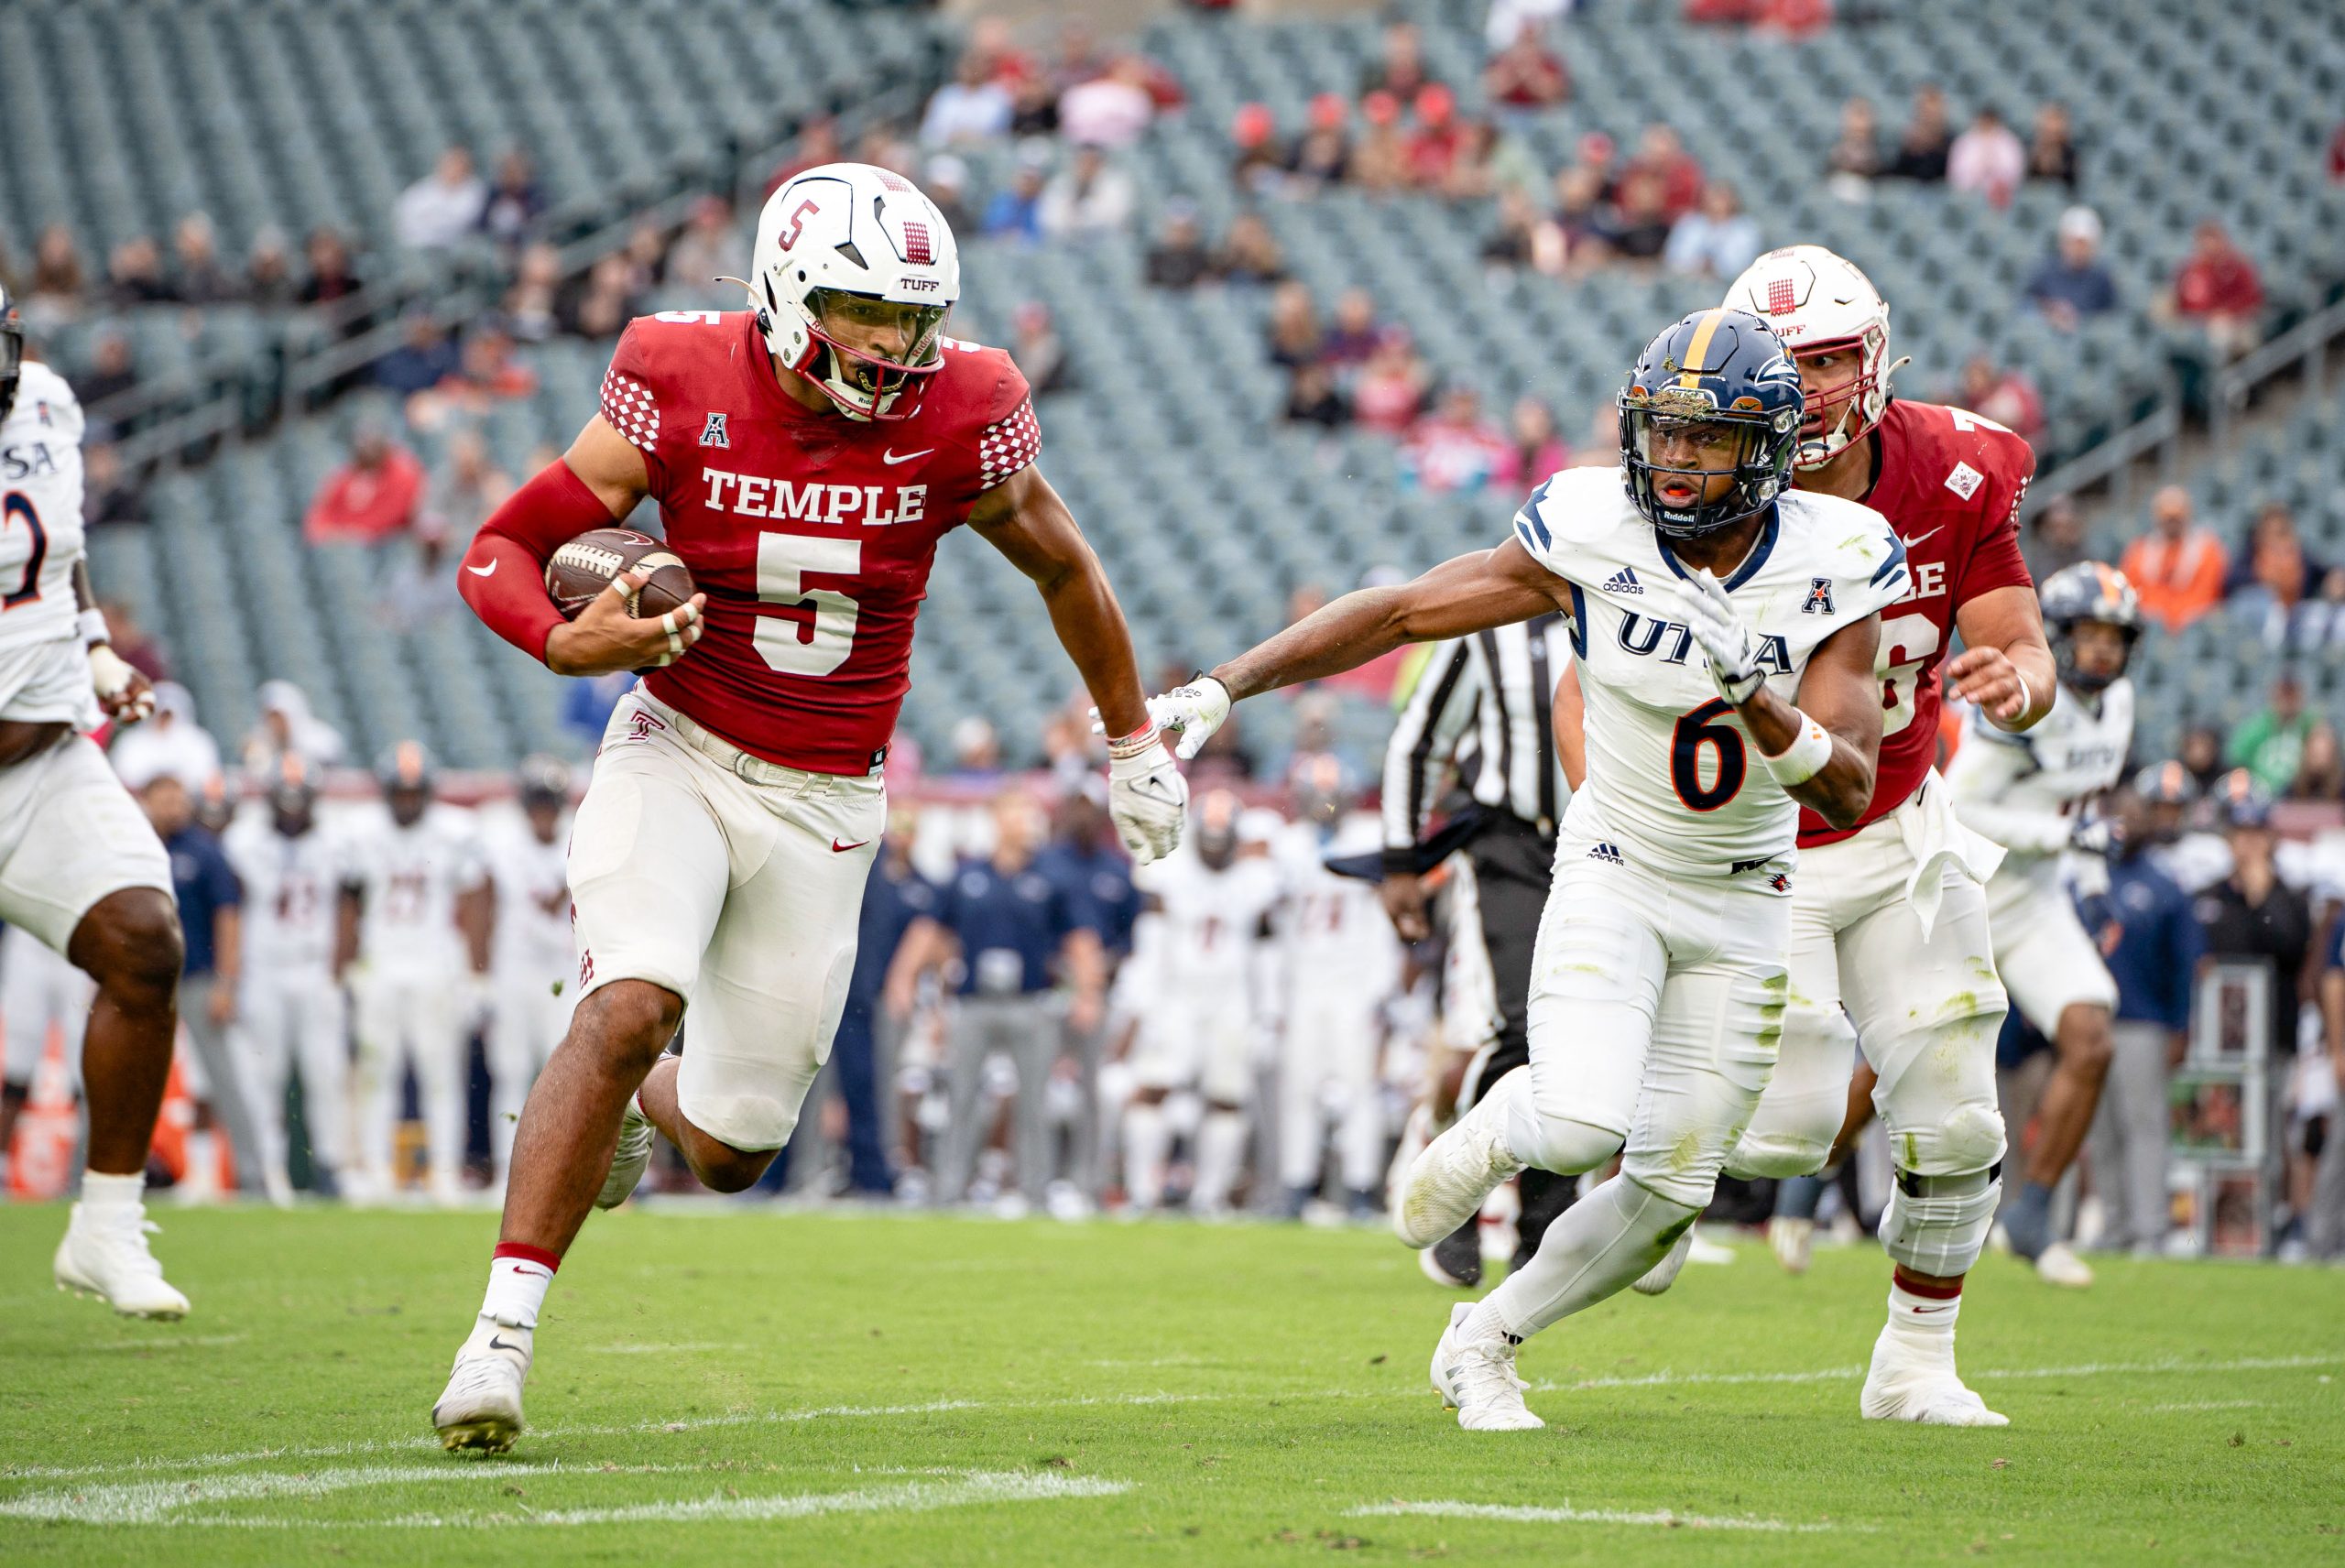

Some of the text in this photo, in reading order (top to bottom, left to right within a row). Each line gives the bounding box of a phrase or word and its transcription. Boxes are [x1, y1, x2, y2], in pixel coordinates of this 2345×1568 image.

[779, 199, 821, 253] 5
[900, 278, 940, 292] TUFF
[1773, 324, 1805, 337] UFF
[703, 466, 928, 526] TEMPLE
[1663, 510, 1695, 523] Riddell
[751, 530, 862, 677] 5
[1603, 579, 1644, 595] adidas
[1617, 608, 1794, 677] UTA
[1669, 696, 1748, 812] 6
